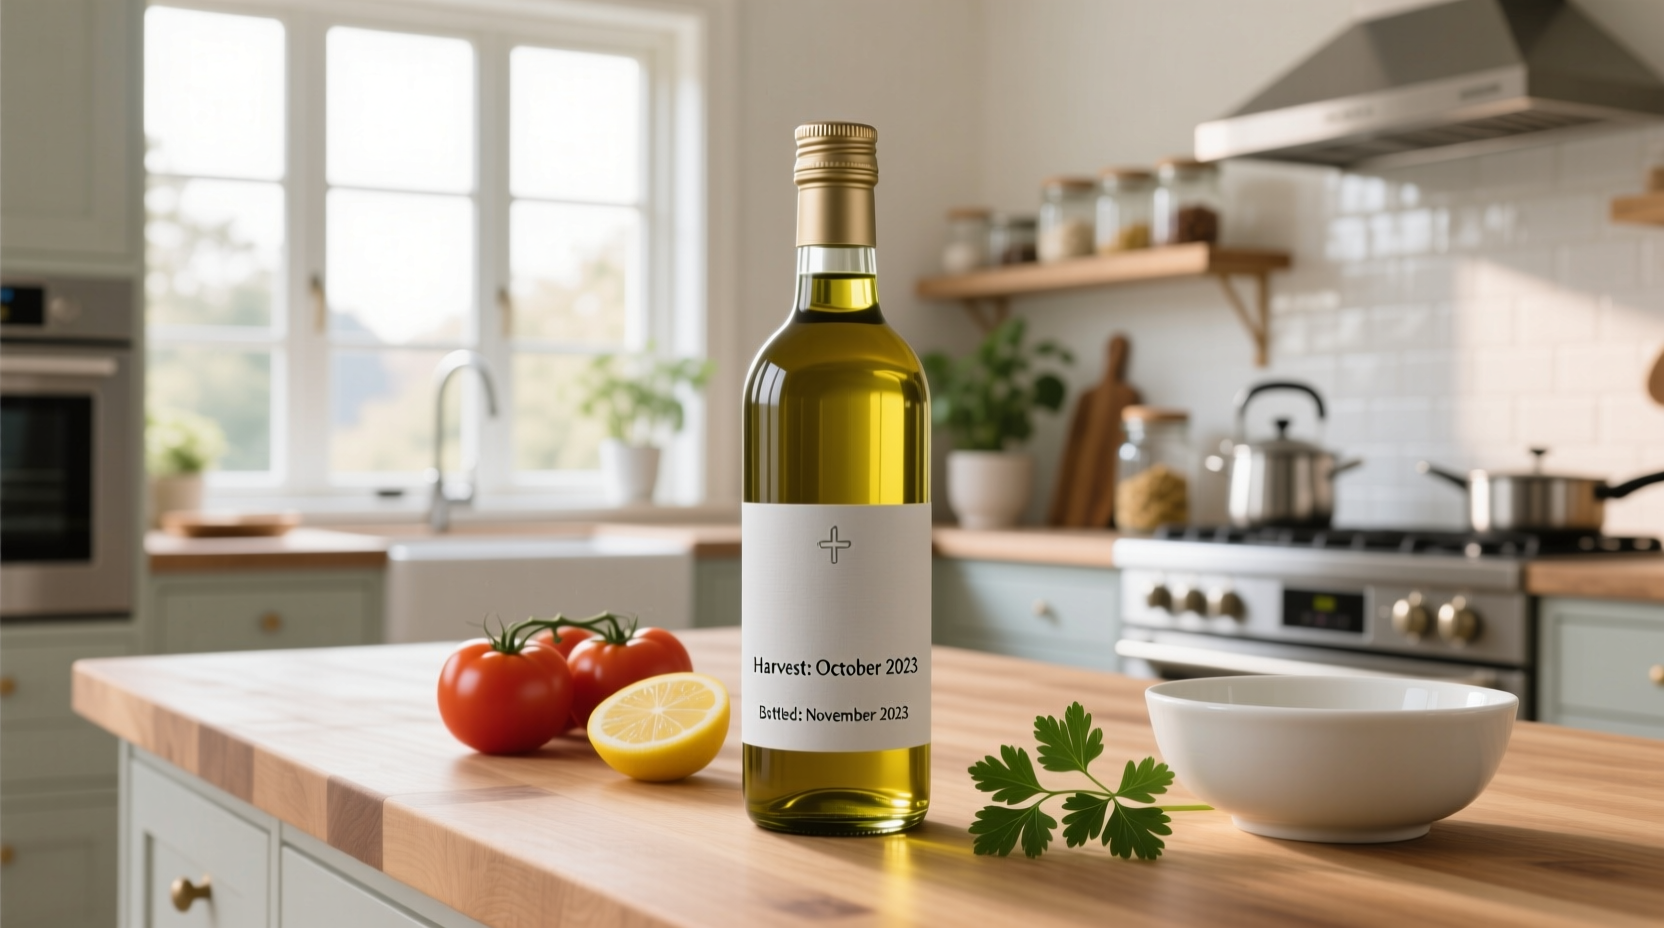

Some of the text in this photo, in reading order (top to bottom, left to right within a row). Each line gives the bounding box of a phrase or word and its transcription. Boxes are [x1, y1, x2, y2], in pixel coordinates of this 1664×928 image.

[753, 656, 919, 676] Harvest: October 2023
[806, 706, 877, 722] November
[879, 705, 909, 721] 2023
